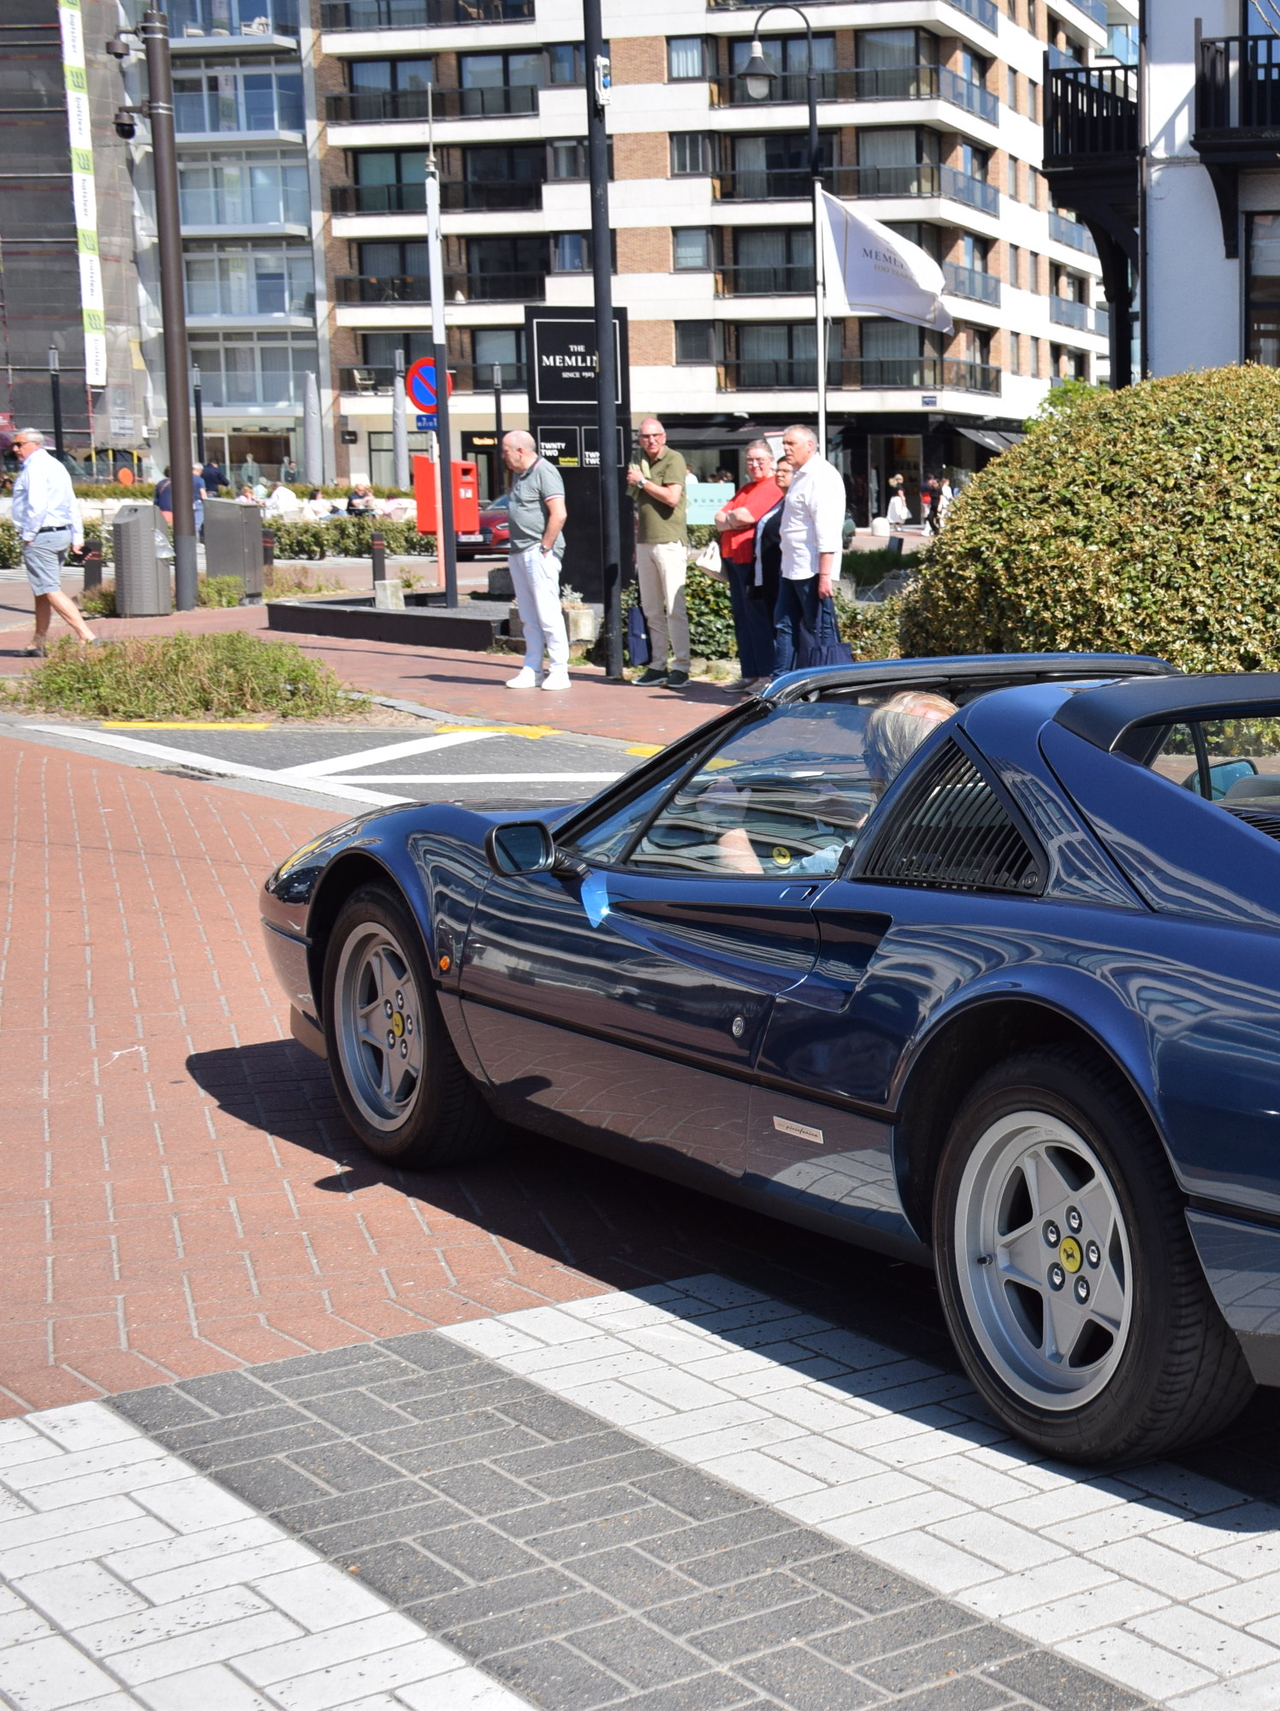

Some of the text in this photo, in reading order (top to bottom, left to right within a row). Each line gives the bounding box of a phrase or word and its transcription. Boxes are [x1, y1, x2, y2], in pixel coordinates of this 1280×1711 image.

[568, 344, 586, 353] THE
[561, 371, 580, 379] SINCE
[540, 449, 559, 457] TWO
